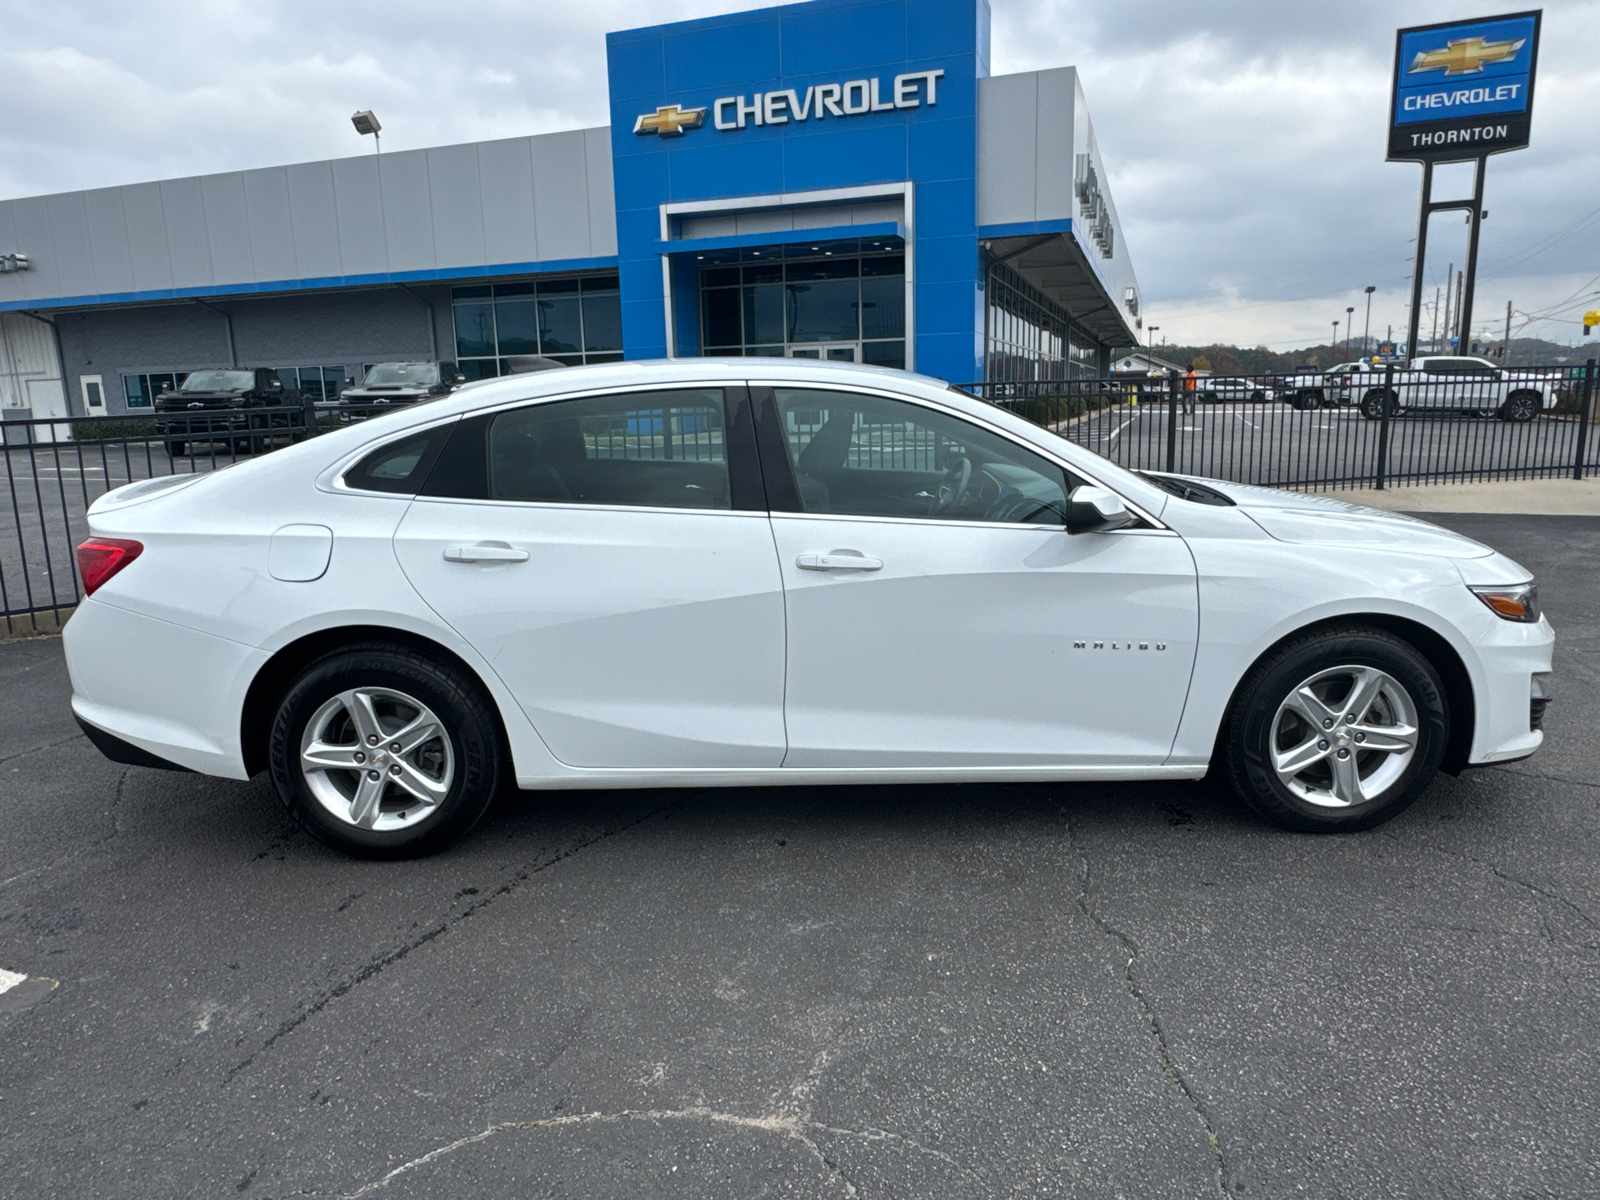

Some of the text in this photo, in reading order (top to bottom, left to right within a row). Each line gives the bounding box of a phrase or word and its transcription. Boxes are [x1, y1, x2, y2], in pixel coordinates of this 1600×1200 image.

[714, 69, 945, 131] CHEVROLET
[1404, 84, 1521, 111] CHEVROLET
[1411, 125, 1508, 146] THORNTON
[1073, 640, 1167, 651] MALIBU
